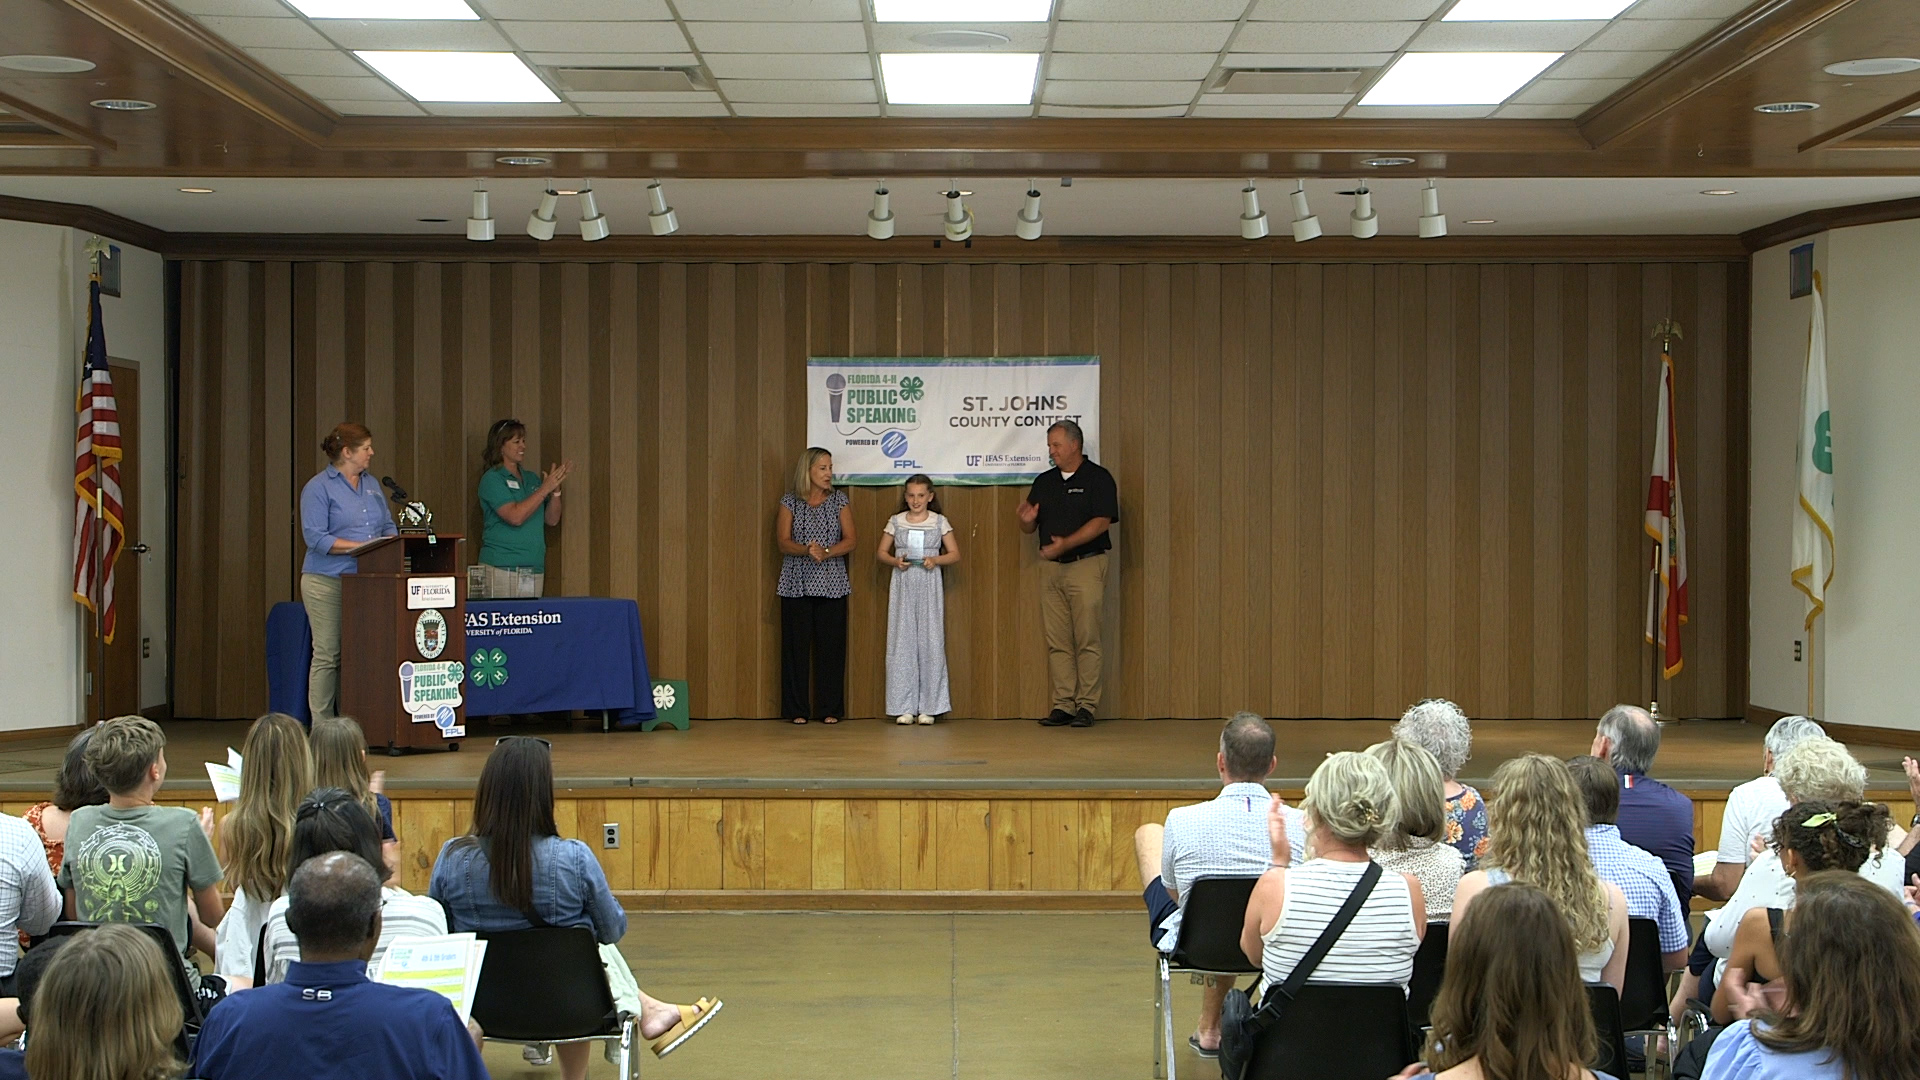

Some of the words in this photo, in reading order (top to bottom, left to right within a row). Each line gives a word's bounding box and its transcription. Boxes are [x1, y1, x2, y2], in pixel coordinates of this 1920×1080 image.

[847, 374, 881, 384] FLORIDA
[882, 374, 897, 384] 4-H
[847, 389, 898, 405] PUBLIC
[962, 396, 993, 411] ST.
[999, 395, 1068, 411] JOHNS
[846, 407, 916, 423] SPEAKING
[949, 416, 1010, 428] COUNTY
[894, 460, 921, 469] FPL
[966, 455, 982, 466] UF
[1004, 454, 1041, 462] Extension
[411, 585, 421, 596] UF
[491, 610, 562, 626] Extension
[495, 628, 502, 637] of
[503, 627, 533, 636] FLORIDA
[414, 664, 436, 672] FLORIDA
[436, 663, 446, 671] 4-H
[414, 673, 446, 688] PUBLIC
[414, 687, 458, 702] SPEAKING
[445, 728, 463, 736] FPL
[302, 988, 333, 1001] SB
